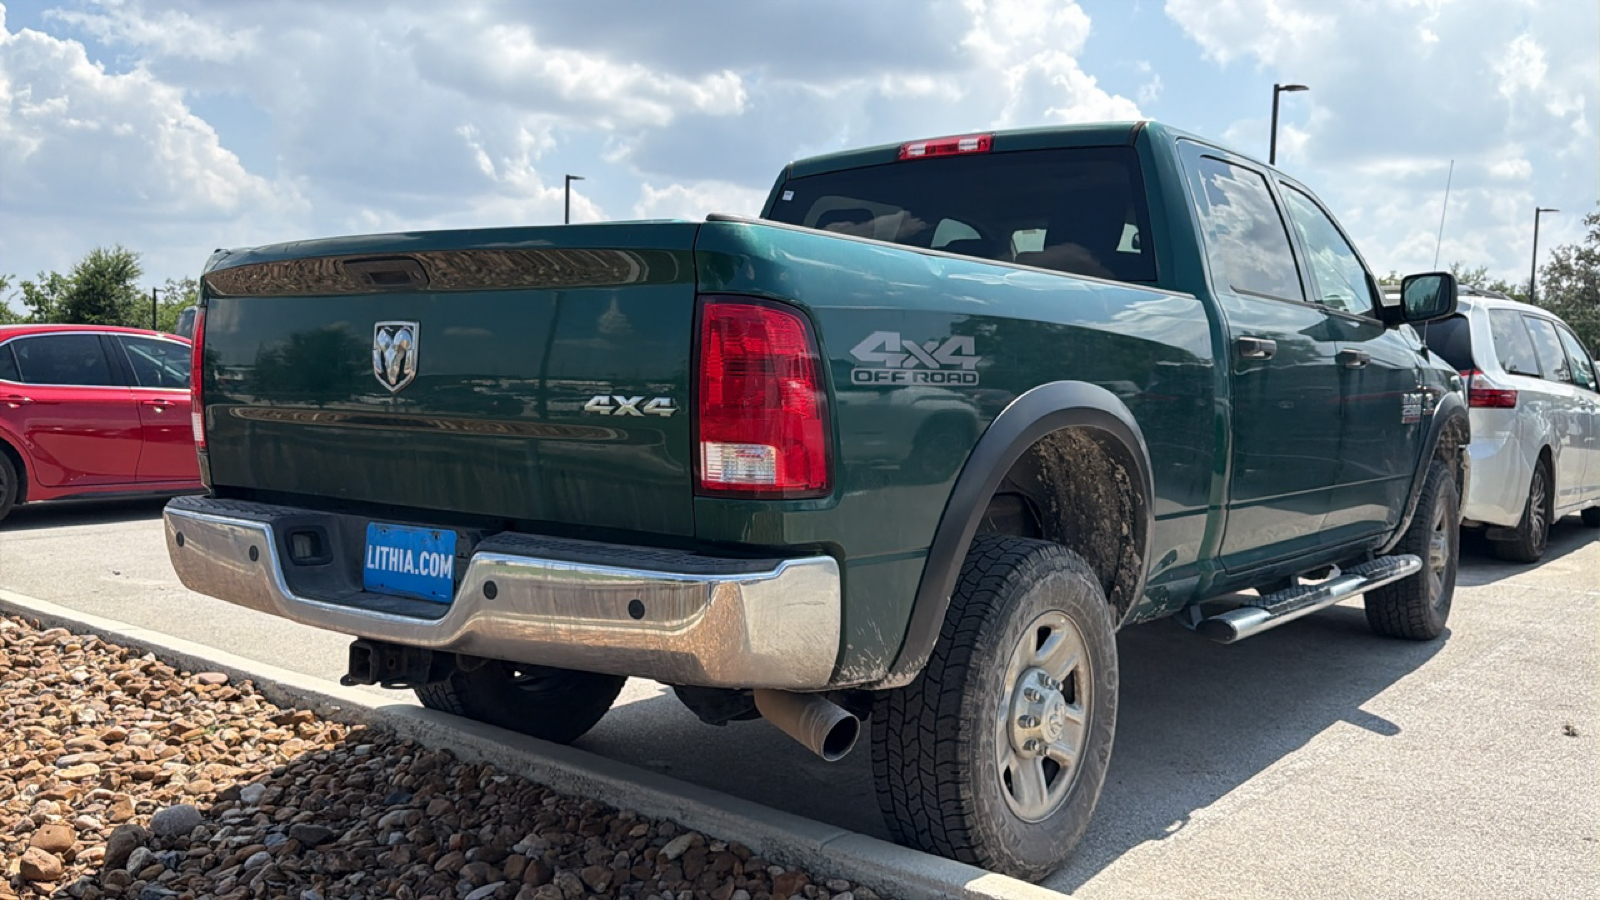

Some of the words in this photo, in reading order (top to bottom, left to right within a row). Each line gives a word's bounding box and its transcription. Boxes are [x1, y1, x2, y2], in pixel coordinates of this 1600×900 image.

[853, 369, 906, 383] OFF
[912, 371, 977, 384] ROAD
[366, 544, 454, 580] LITHIA.COM
